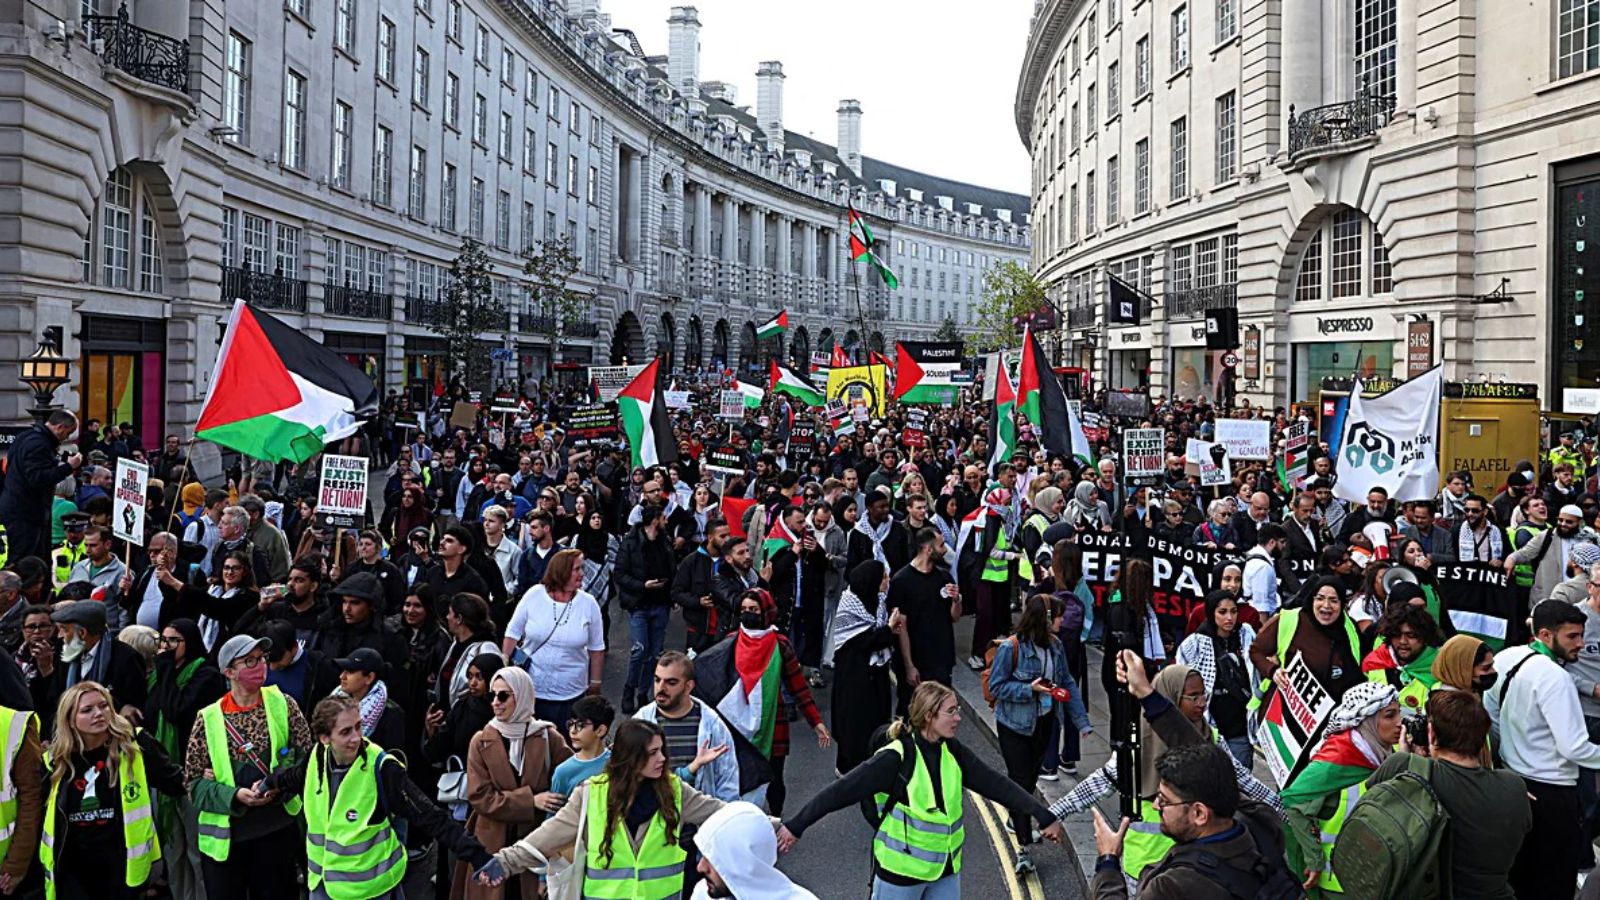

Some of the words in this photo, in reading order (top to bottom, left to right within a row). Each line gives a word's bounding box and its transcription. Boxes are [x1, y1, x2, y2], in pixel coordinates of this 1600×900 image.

[1317, 316, 1374, 336] NESPRESSO
[922, 349, 956, 357] PALESTINE
[1463, 385, 1520, 397] FALAFEL
[791, 428, 814, 437] STOP
[1289, 422, 1305, 438] FREE
[1127, 440, 1162, 448] EXIST!
[1454, 458, 1511, 472] FALAFEL
[324, 468, 365, 481] EXIST!
[323, 479, 365, 490] RESIST!
[321, 488, 364, 509] RETURN!
[1074, 533, 1132, 548] IONAL
[1081, 551, 1121, 582] EE
[1437, 566, 1509, 587] ESTINE
[1288, 658, 1327, 714] FREE
